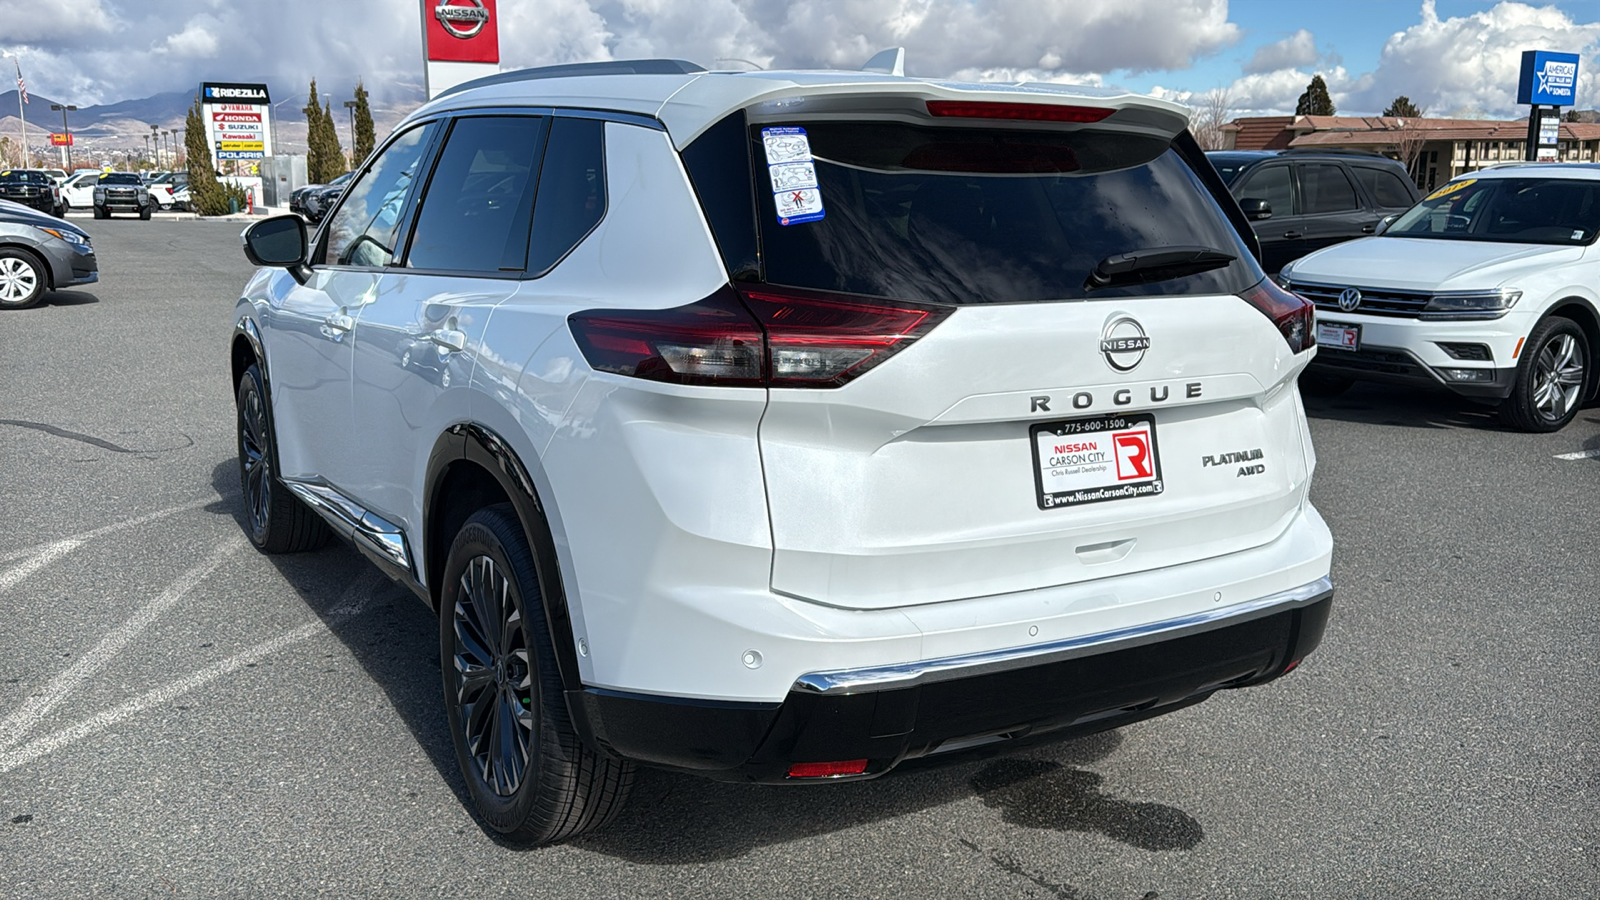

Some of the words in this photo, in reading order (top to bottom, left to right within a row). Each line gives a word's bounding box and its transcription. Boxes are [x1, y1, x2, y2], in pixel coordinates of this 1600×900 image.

[441, 8, 485, 18] NISSAN
[1548, 64, 1574, 75] AMERICAS
[220, 88, 266, 98] RIDEZILLA
[1102, 339, 1150, 350] NISSAN
[1030, 382, 1203, 413] ROGUE
[1065, 418, 1125, 433] 775-600-1500
[1054, 442, 1098, 454] NISSAN
[1049, 454, 1086, 467] CARSON
[1087, 452, 1106, 463] CITY
[1202, 448, 1264, 467] PLATINUM
[1081, 465, 1107, 474] Dealership
[1236, 464, 1266, 477] AWD
[1054, 485, 1153, 504] www.NissanCarsonCity.com
